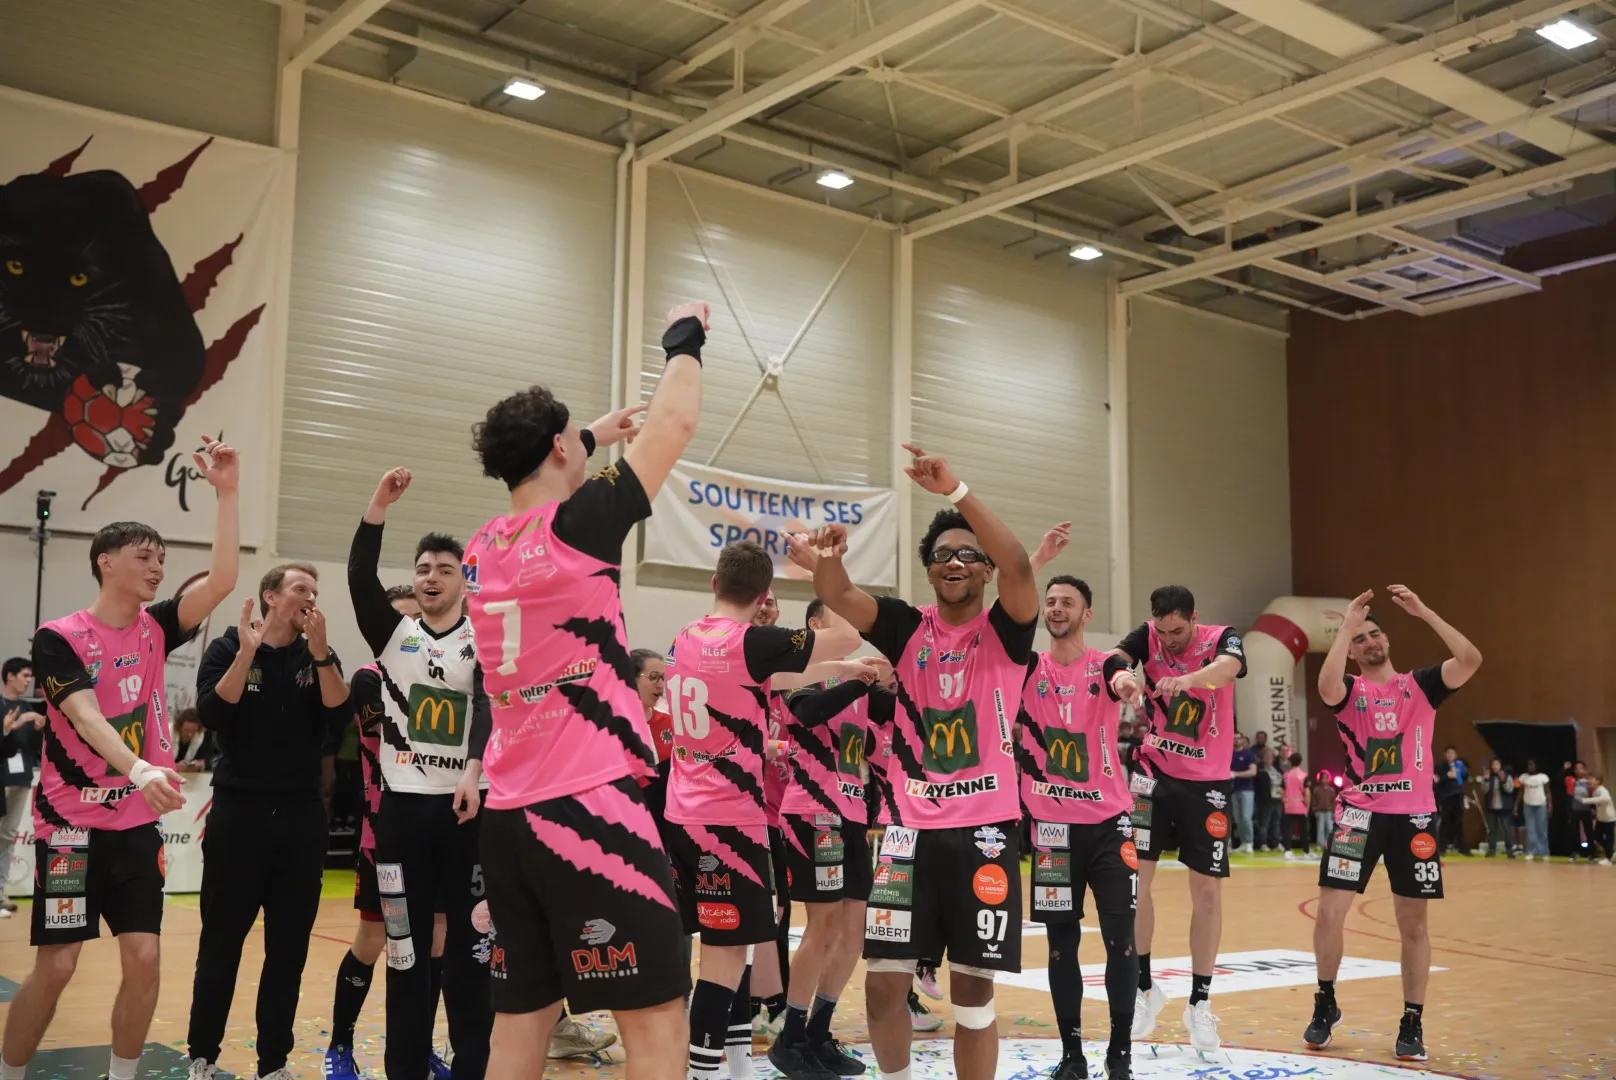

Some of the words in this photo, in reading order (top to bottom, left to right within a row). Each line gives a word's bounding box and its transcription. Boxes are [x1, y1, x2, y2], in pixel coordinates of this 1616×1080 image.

[688, 480, 815, 520] SOUTIENT
[823, 500, 863, 525] SES
[710, 523, 795, 555] SPORT
[483, 598, 521, 676] 7
[701, 648, 727, 657] HLGE
[117, 674, 143, 704] 19
[247, 684, 260, 692] RL
[667, 674, 710, 740] 13
[1270, 676, 1287, 748] AYENNE
[1375, 711, 1398, 732] 33
[395, 752, 467, 771] MAYENN
[906, 775, 996, 798] MAYENNE
[1033, 782, 1102, 800] MAYENNE
[1360, 781, 1411, 793] AYENNE
[1212, 840, 1225, 861] 3
[1328, 868, 1359, 879] HUBERT
[1414, 861, 1440, 882] 33
[1129, 872, 1139, 896] 1
[1035, 899, 1071, 908] HUBERT
[45, 914, 86, 924] HUBERT
[977, 908, 1008, 941] 97
[866, 926, 910, 938] HUBERT
[571, 941, 637, 973] DLM
